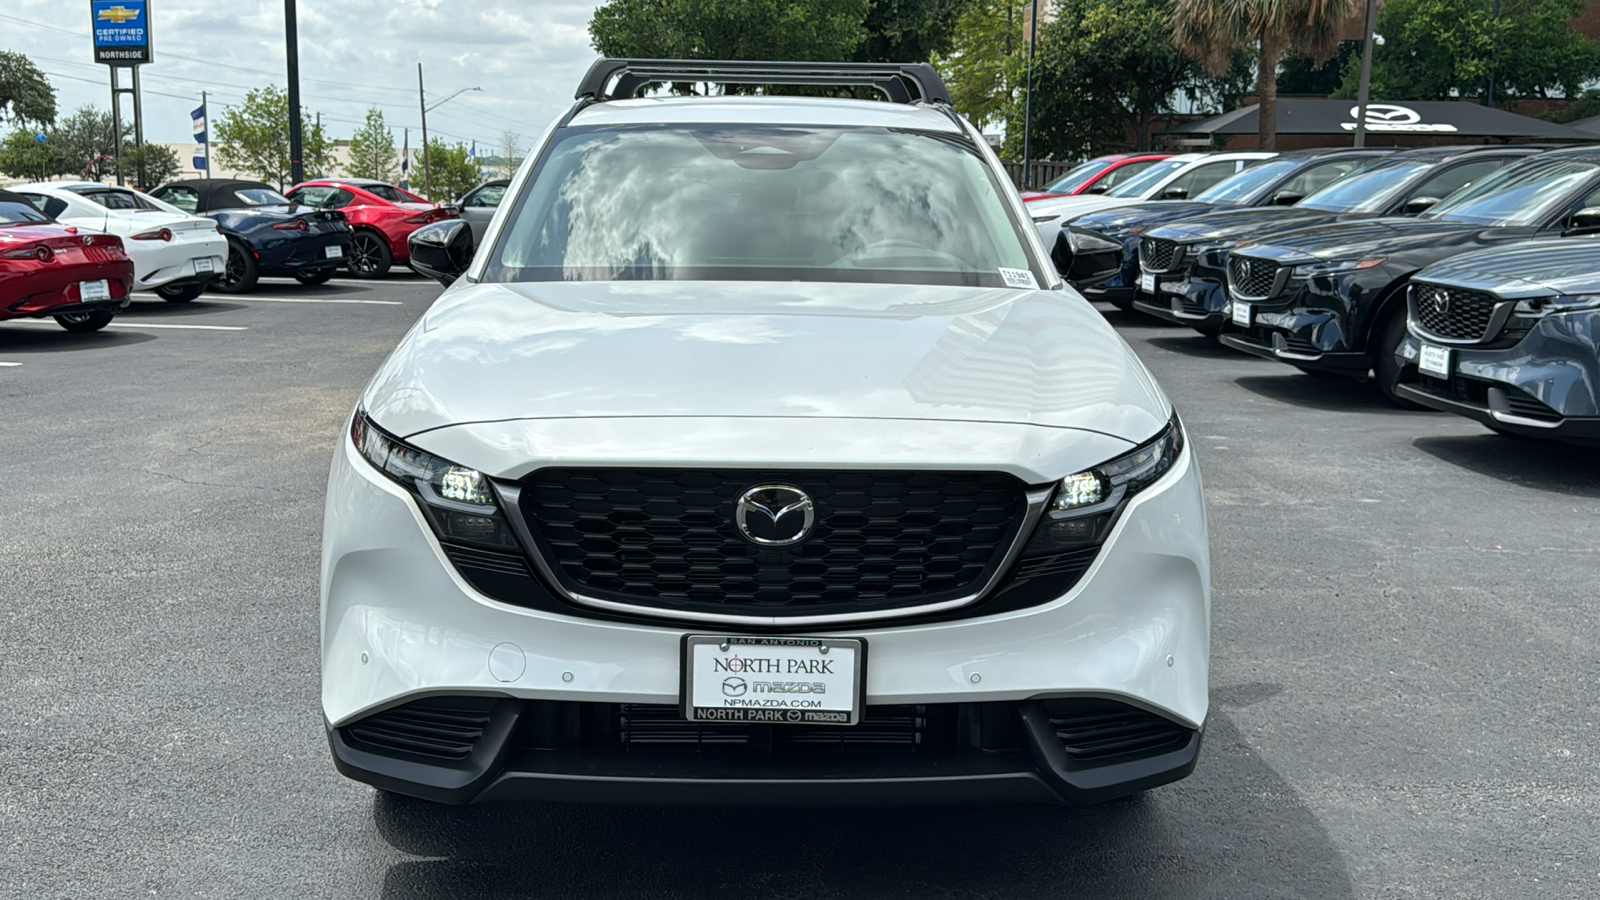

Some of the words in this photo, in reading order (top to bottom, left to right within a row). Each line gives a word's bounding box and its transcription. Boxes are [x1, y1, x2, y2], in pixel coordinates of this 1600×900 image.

[99, 50, 142, 59] NORTHSIDE
[761, 639, 820, 647] ANTONIO
[713, 656, 780, 673] NORTH
[787, 659, 835, 674] PARK
[753, 681, 826, 694] mazda
[724, 699, 822, 708] NPMAZDA.COM
[697, 709, 744, 720] NORTH
[748, 710, 783, 721] PARK
[805, 712, 848, 722] mazda
